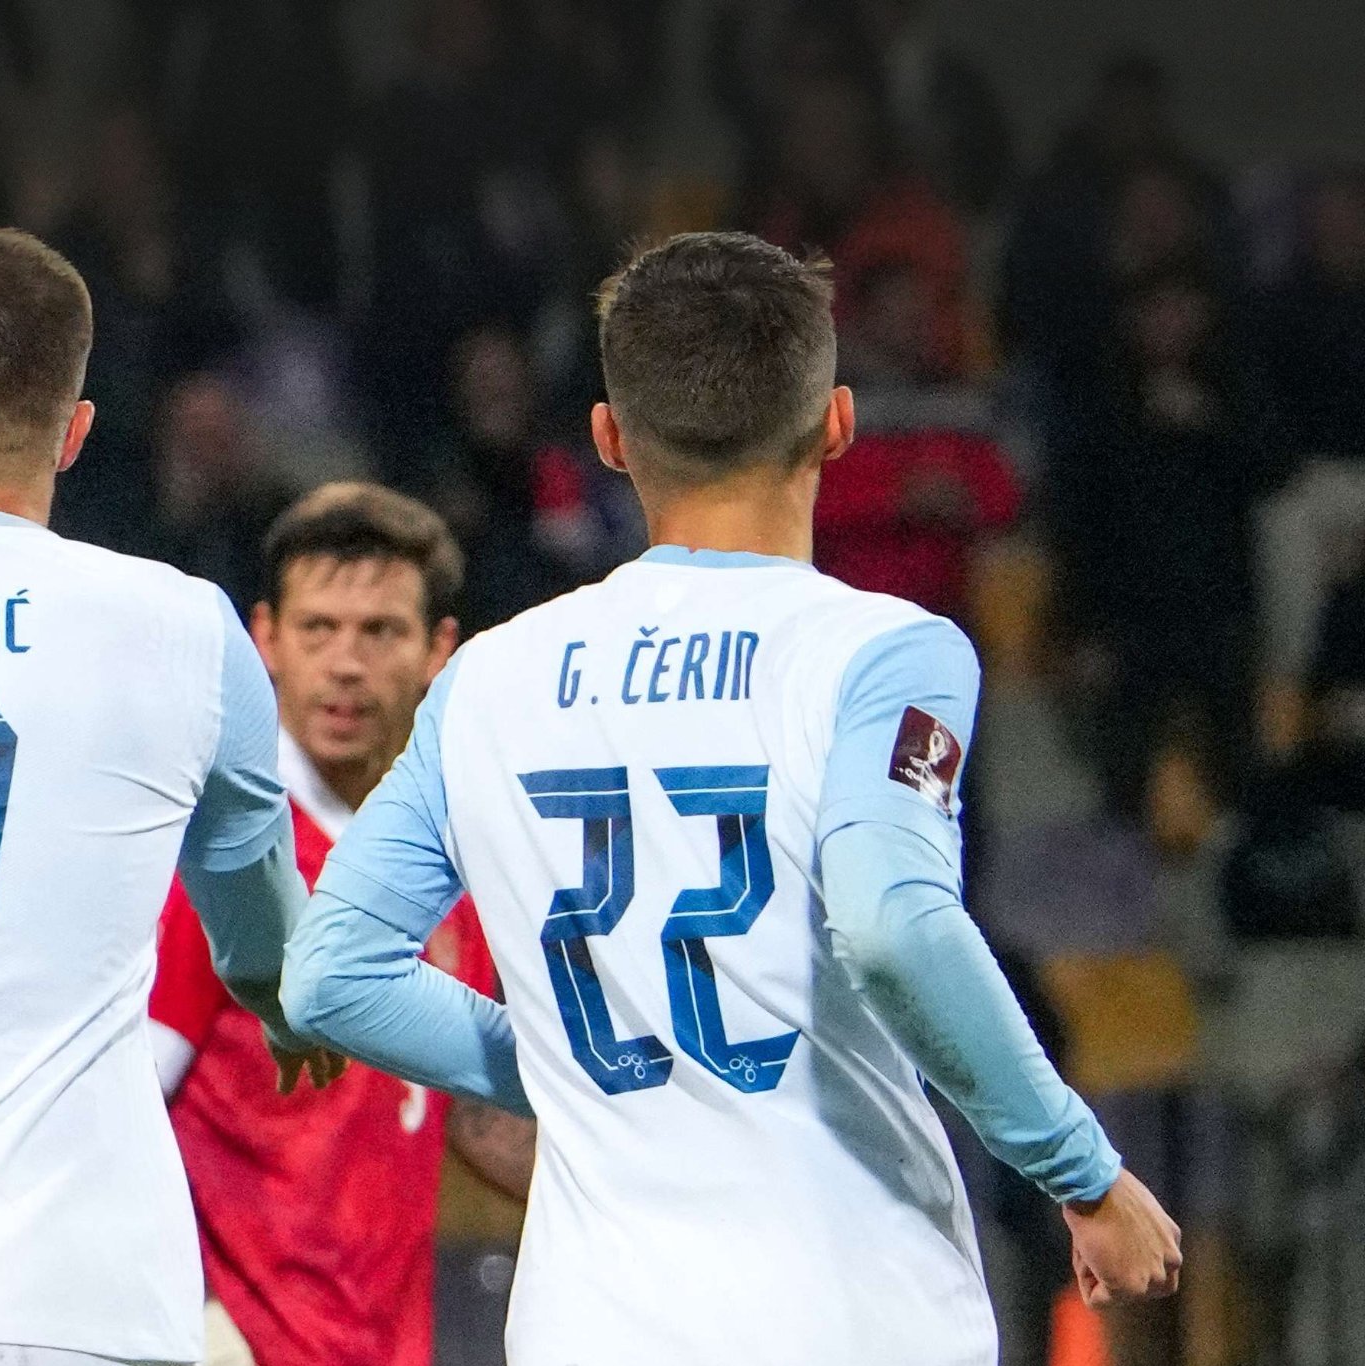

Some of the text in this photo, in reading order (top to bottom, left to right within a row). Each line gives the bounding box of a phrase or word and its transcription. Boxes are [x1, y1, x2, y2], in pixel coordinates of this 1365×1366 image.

[556, 625, 760, 709] G. ČERIN
[516, 764, 801, 1096] 22
